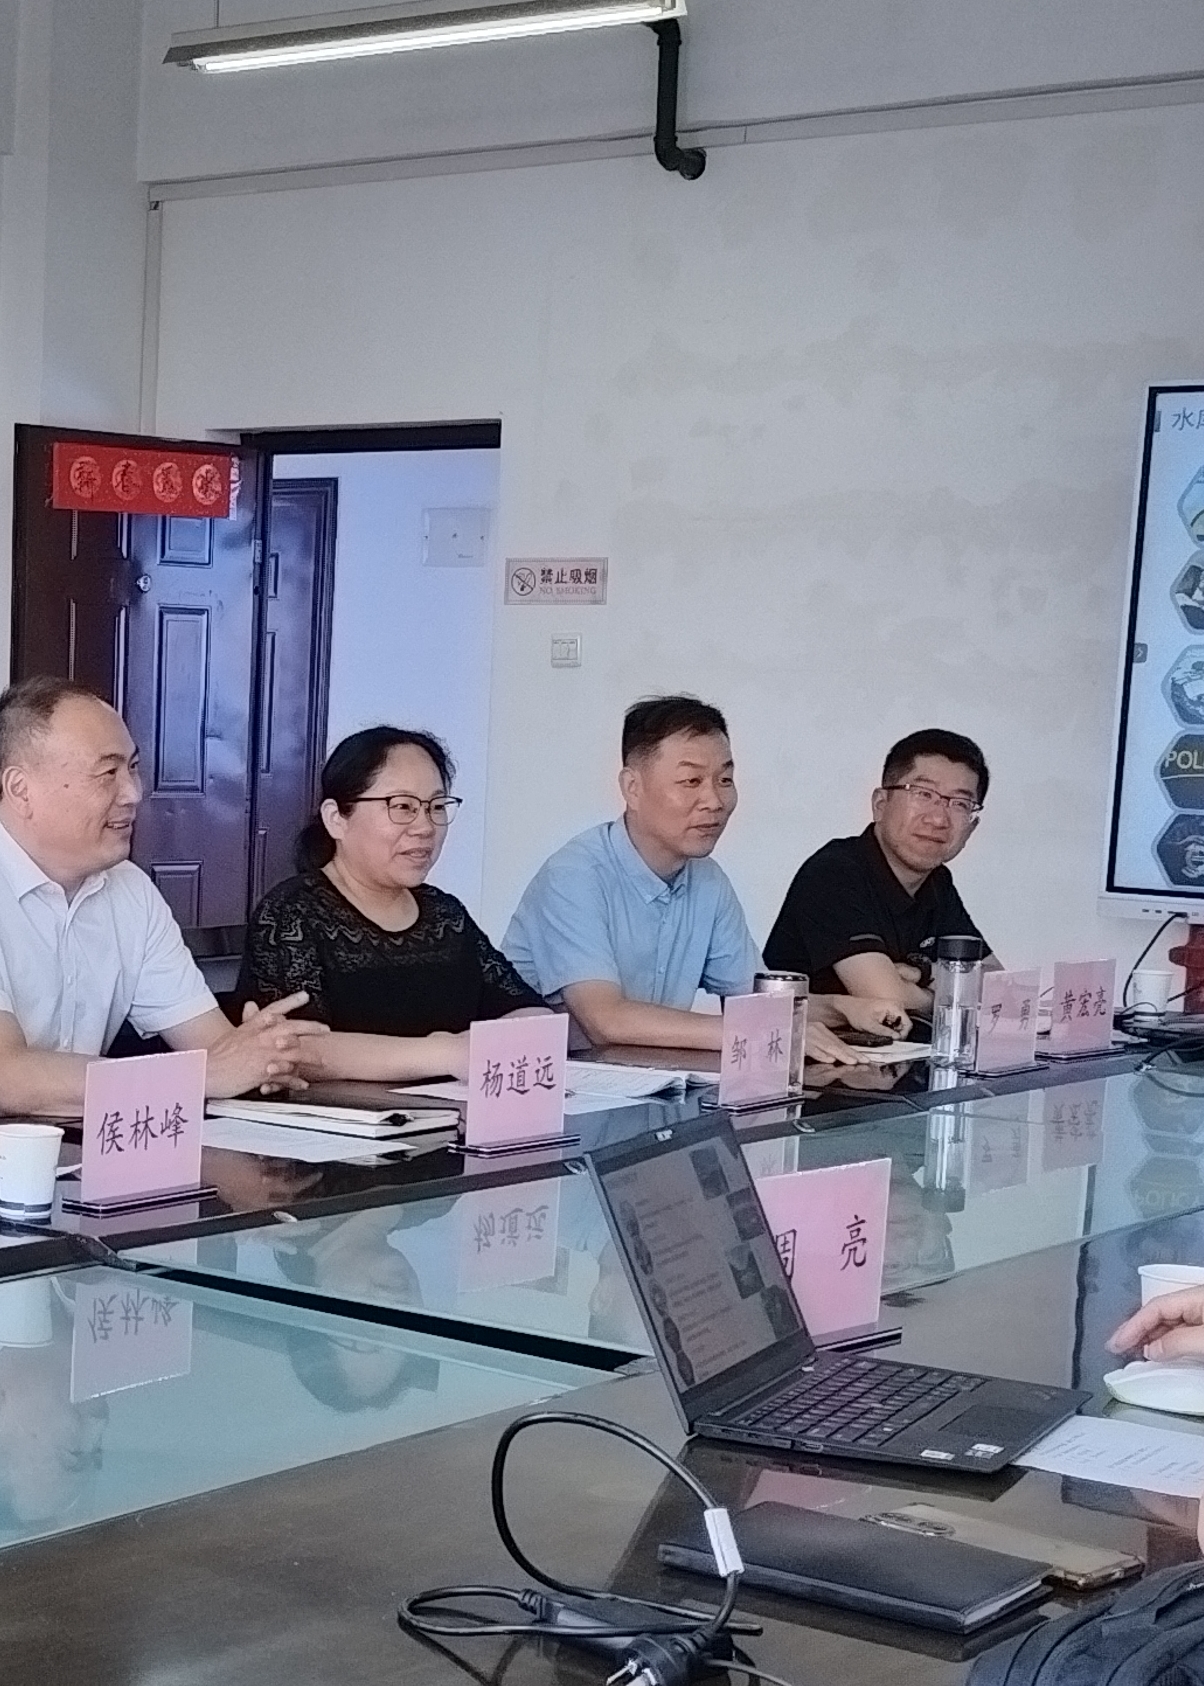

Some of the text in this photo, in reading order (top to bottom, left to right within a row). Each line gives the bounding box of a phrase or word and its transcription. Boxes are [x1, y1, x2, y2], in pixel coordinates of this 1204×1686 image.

[539, 567, 598, 585] 禁止吸烟
[539, 586, 597, 595] NO SMOKING
[480, 1054, 557, 1099] 杨道远
[96, 1102, 189, 1155] 侯林峰
